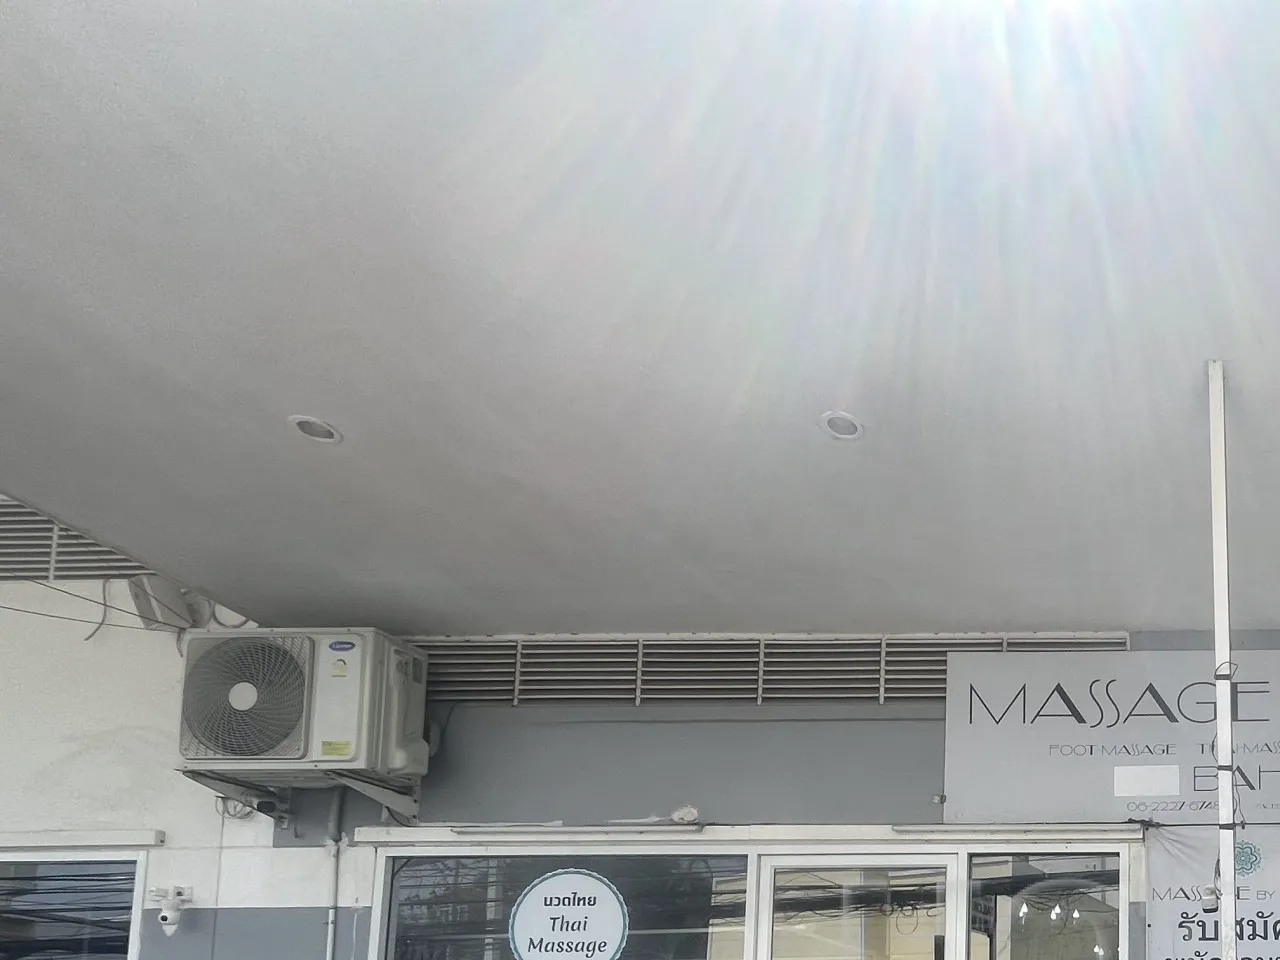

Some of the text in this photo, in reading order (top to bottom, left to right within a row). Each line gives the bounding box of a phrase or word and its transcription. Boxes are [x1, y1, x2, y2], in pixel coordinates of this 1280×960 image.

[968, 678, 1270, 729] MASSAGE
[543, 892, 597, 907] นวดไทย
[1152, 885, 1250, 901] MASSE
[1256, 889, 1276, 900] BY
[549, 915, 588, 932] Thai
[527, 937, 607, 958] Massage
